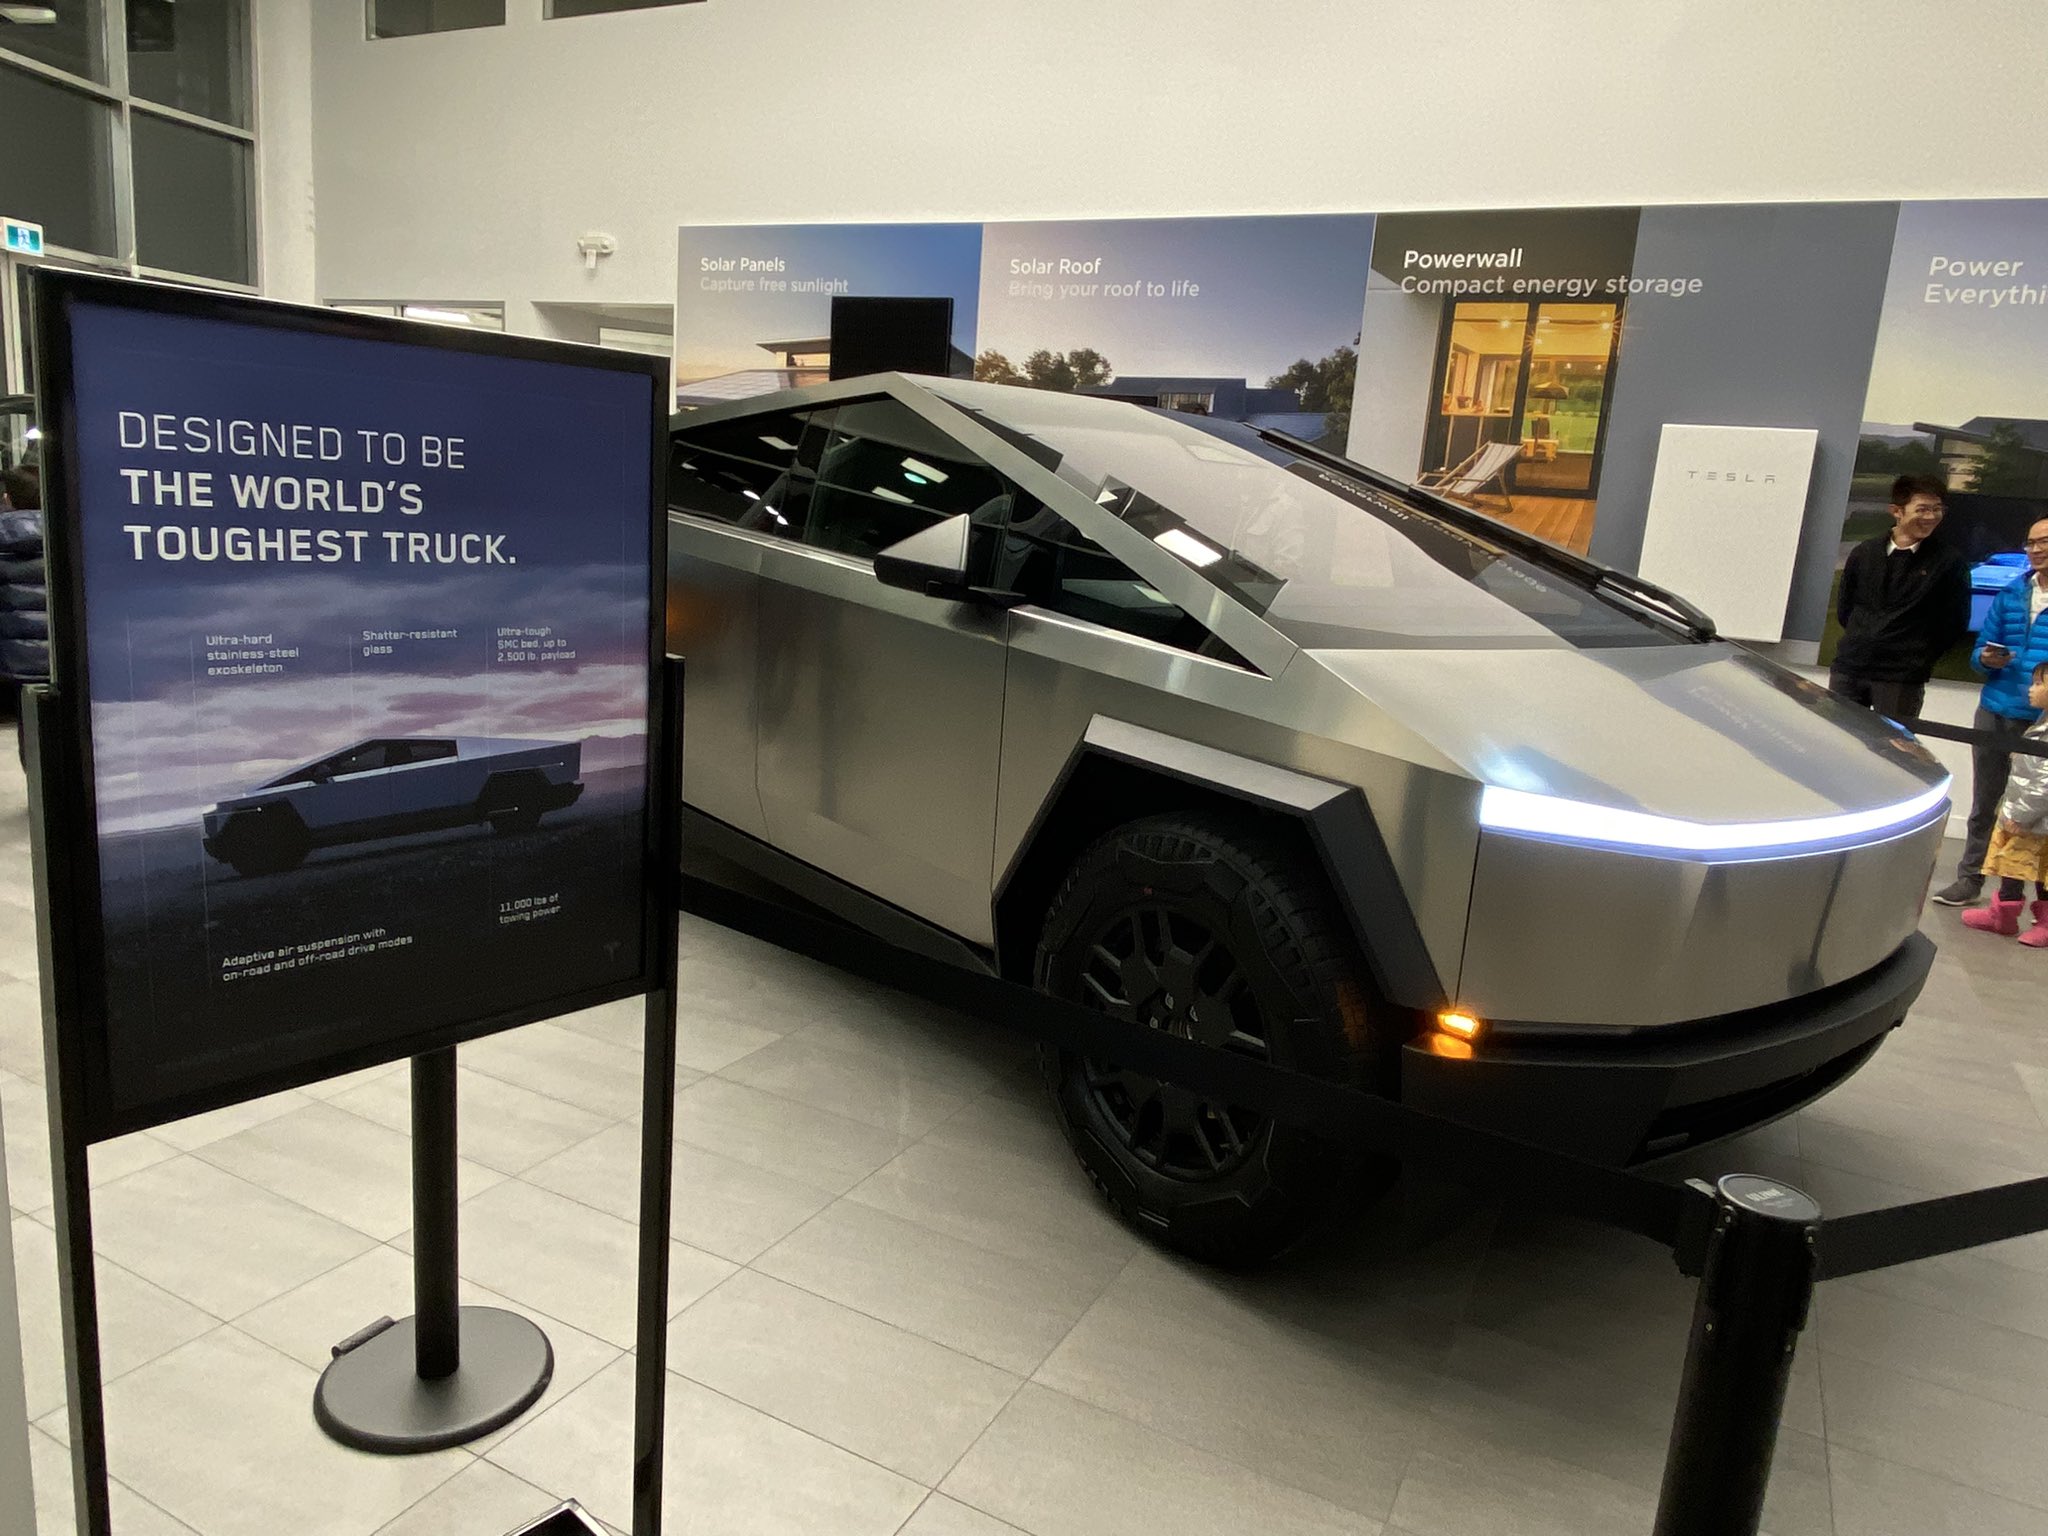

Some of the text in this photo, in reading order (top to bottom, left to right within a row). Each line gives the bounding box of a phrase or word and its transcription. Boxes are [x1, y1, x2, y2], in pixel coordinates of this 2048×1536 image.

[700, 257, 786, 273] Solar Panels
[1009, 257, 1102, 275] Solar Roof
[1403, 248, 1523, 269] Powerwall
[1929, 255, 2024, 277] Power
[700, 276, 849, 296] Capture free sunlight
[1009, 280, 1200, 302] Bring your roof to life
[1400, 275, 1704, 298] Compact energy storage
[1924, 283, 2048, 308] Everythi
[118, 411, 465, 470] DESIGNED TO BE
[1687, 469, 1777, 484] TESLA
[119, 468, 424, 516] THE WORLD'S
[123, 525, 517, 565] TOUGHEST TRUCK.
[206, 634, 272, 646] Ultra-hard
[362, 629, 458, 642] Shatter-resistant
[497, 626, 551, 638] Ultra-tough
[362, 644, 393, 657] glass
[497, 639, 518, 649] SMC
[543, 640, 555, 649] up
[557, 638, 567, 648] to
[207, 648, 299, 660] stainless-steel
[540, 649, 576, 662] payload
[207, 663, 283, 675] exoskeleton
[549, 892, 559, 903] of
[499, 905, 561, 924] towing power
[222, 927, 387, 968] Adaptive air suspension with
[223, 935, 413, 982] on-road and off-road drive modes
